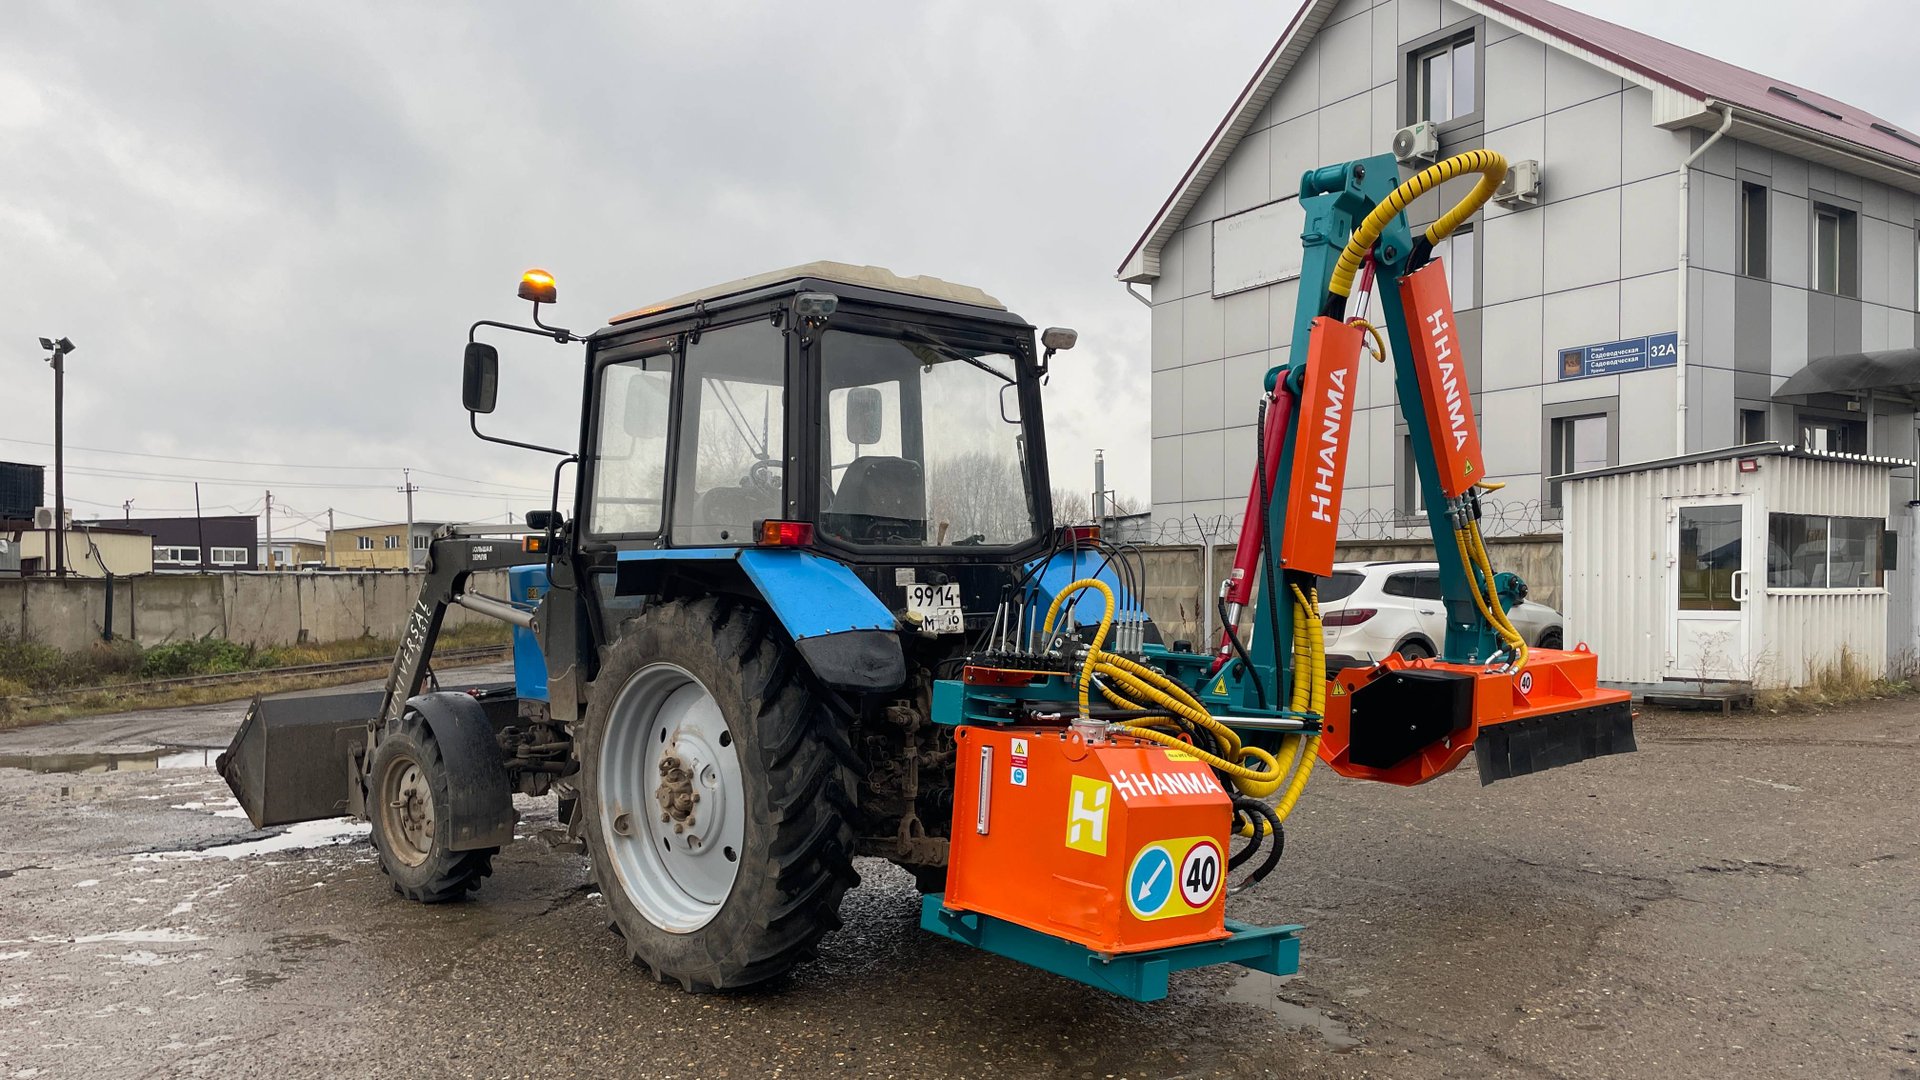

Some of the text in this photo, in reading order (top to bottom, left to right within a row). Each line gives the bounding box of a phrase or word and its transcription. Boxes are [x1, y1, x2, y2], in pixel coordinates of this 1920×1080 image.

[1591, 347, 1639, 359] Садоводческая
[1591, 356, 1639, 368] Садоводческая
[1434, 335, 1468, 452] HANMA
[1315, 368, 1348, 492] HANMA
[914, 586, 954, 607] 9914
[1521, 676, 1531, 689] 40
[1130, 773, 1222, 796] HANMA
[1186, 855, 1216, 893] 40
